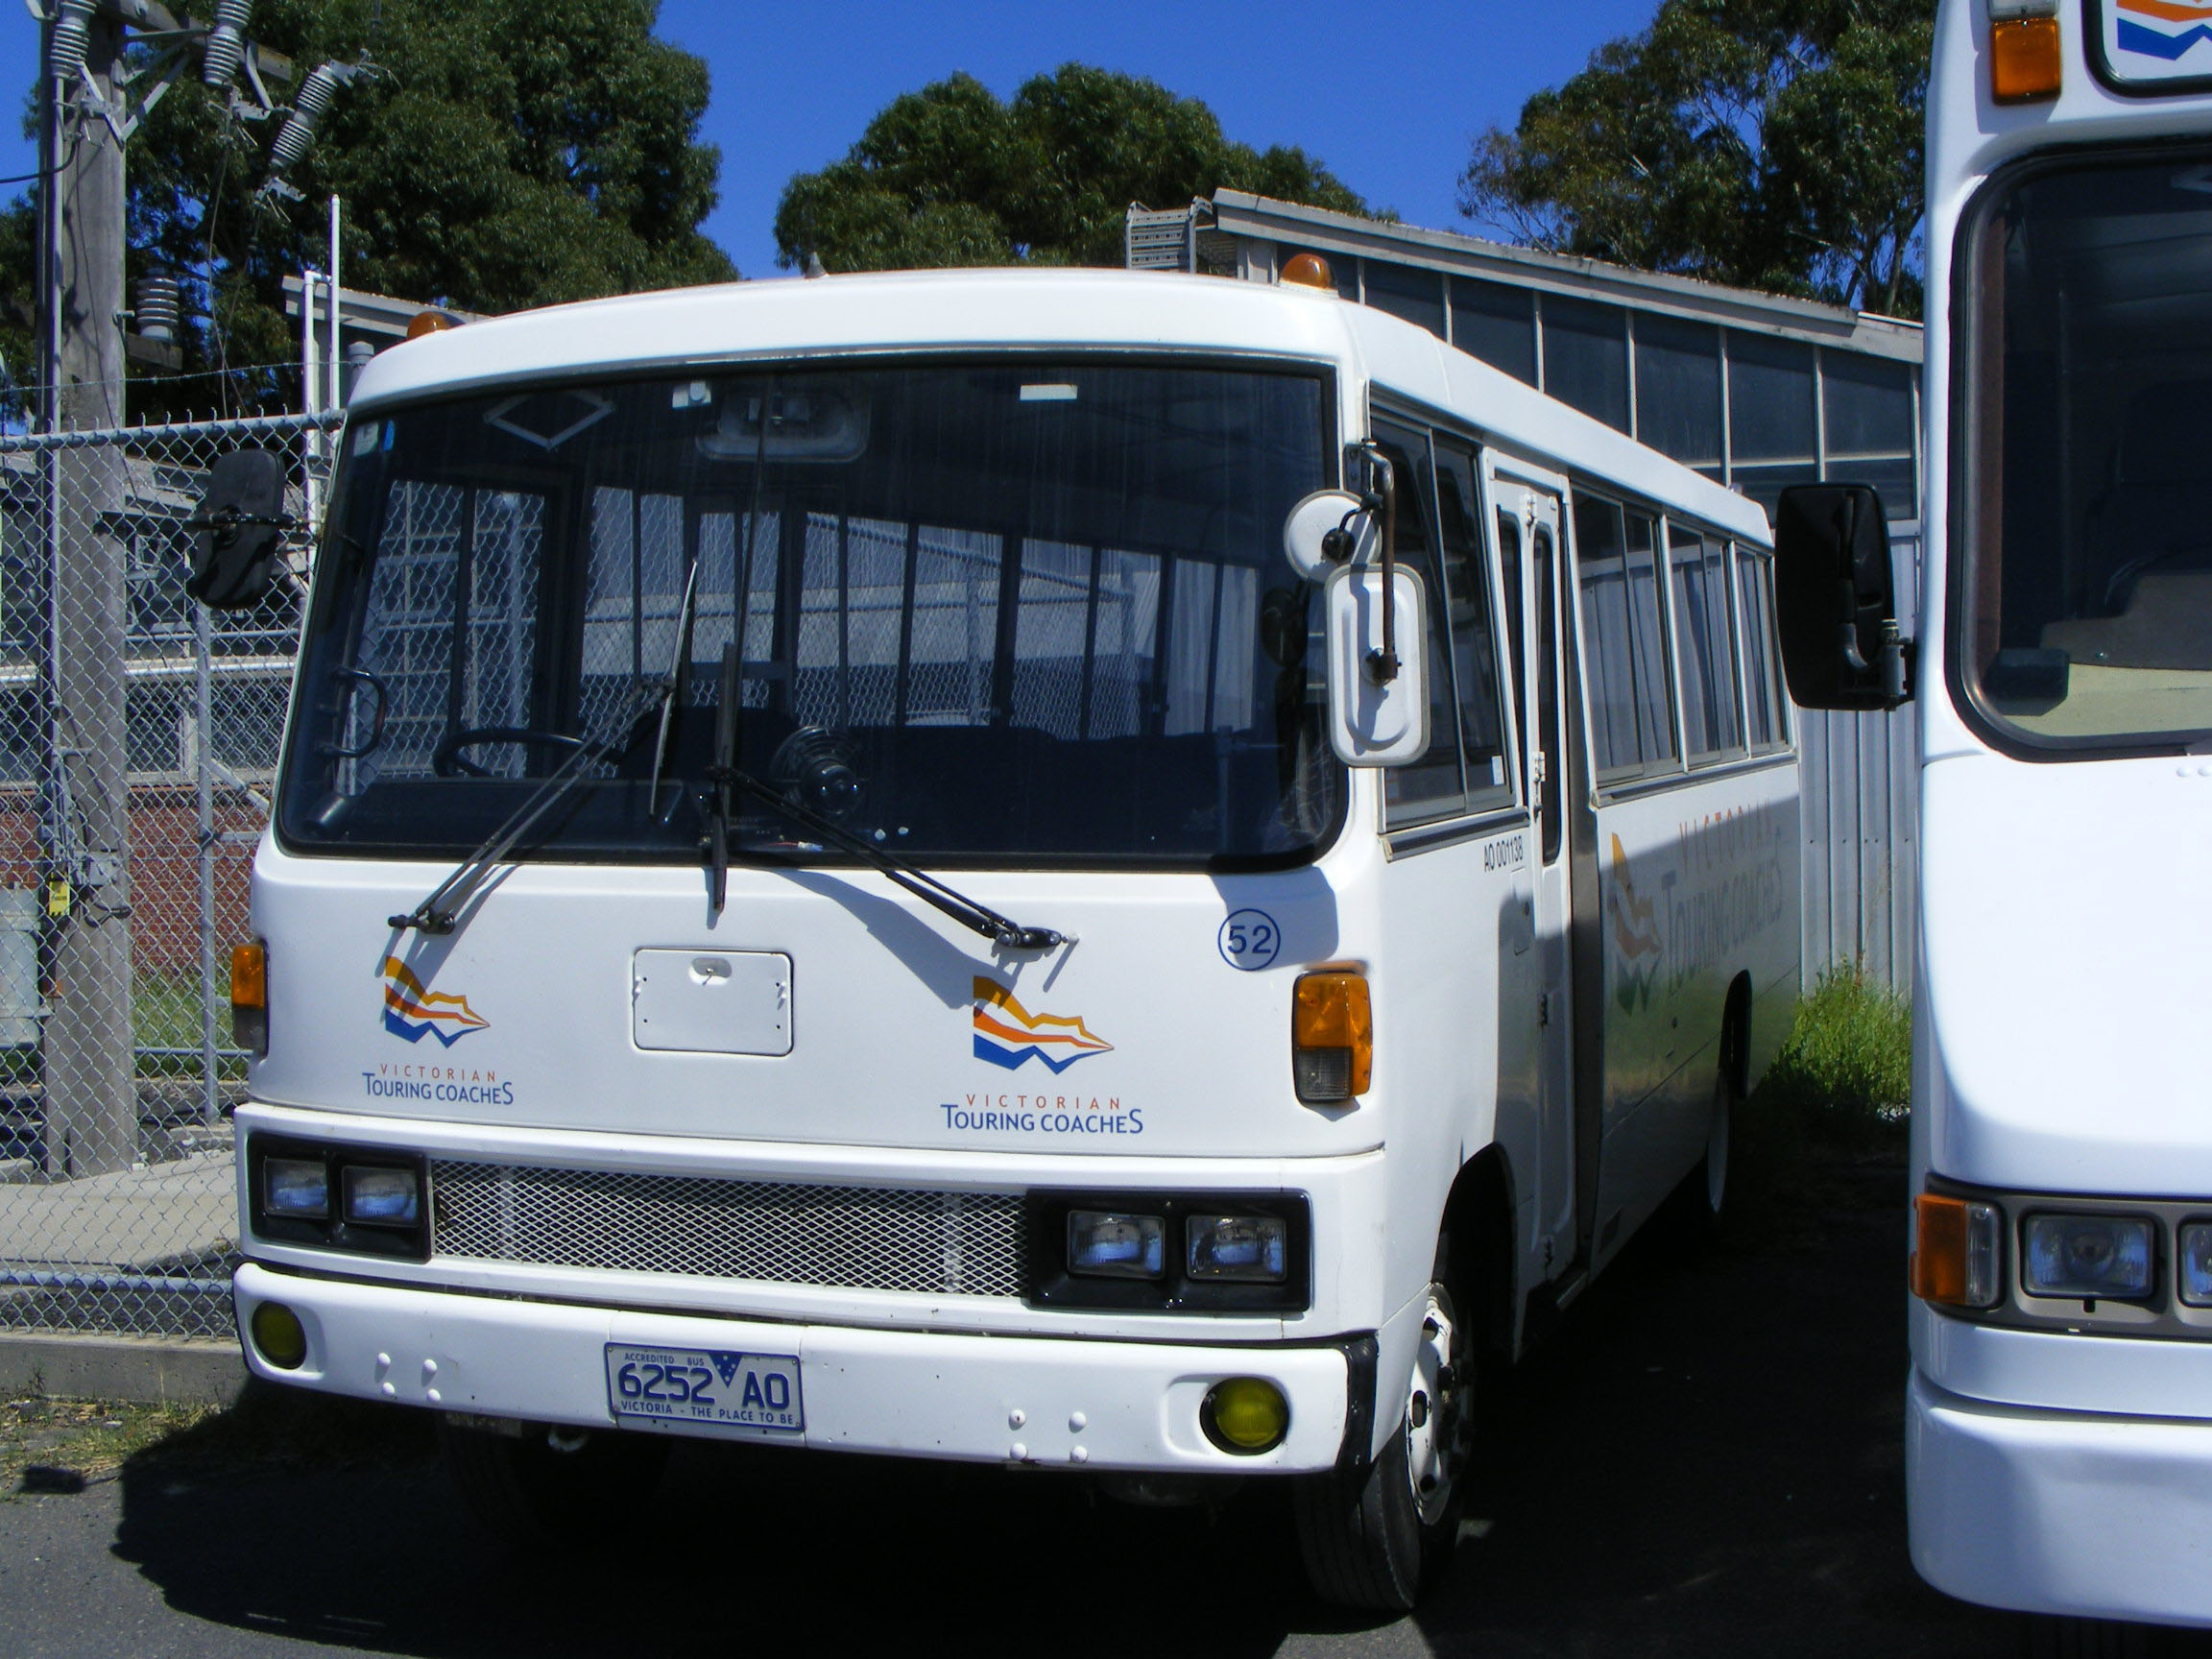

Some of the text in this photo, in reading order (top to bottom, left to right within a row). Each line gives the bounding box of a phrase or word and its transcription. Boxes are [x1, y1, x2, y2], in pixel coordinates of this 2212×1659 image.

[1227, 925, 1272, 954] 52
[380, 1064, 495, 1081] VICTORIAN
[362, 1072, 514, 1105] TOURING COACHES
[966, 1094, 1120, 1110] VICTORIAN
[940, 1104, 1143, 1134] TOURING COACHES
[624, 1353, 705, 1367] ACCREDITED BUS
[618, 1362, 715, 1405] 6252
[621, 1400, 673, 1414] VICTORIA
[690, 1406, 712, 1418] THE
[720, 1408, 754, 1421] PLACE
[759, 1411, 774, 1425] TO
[780, 1414, 793, 1425] BE
